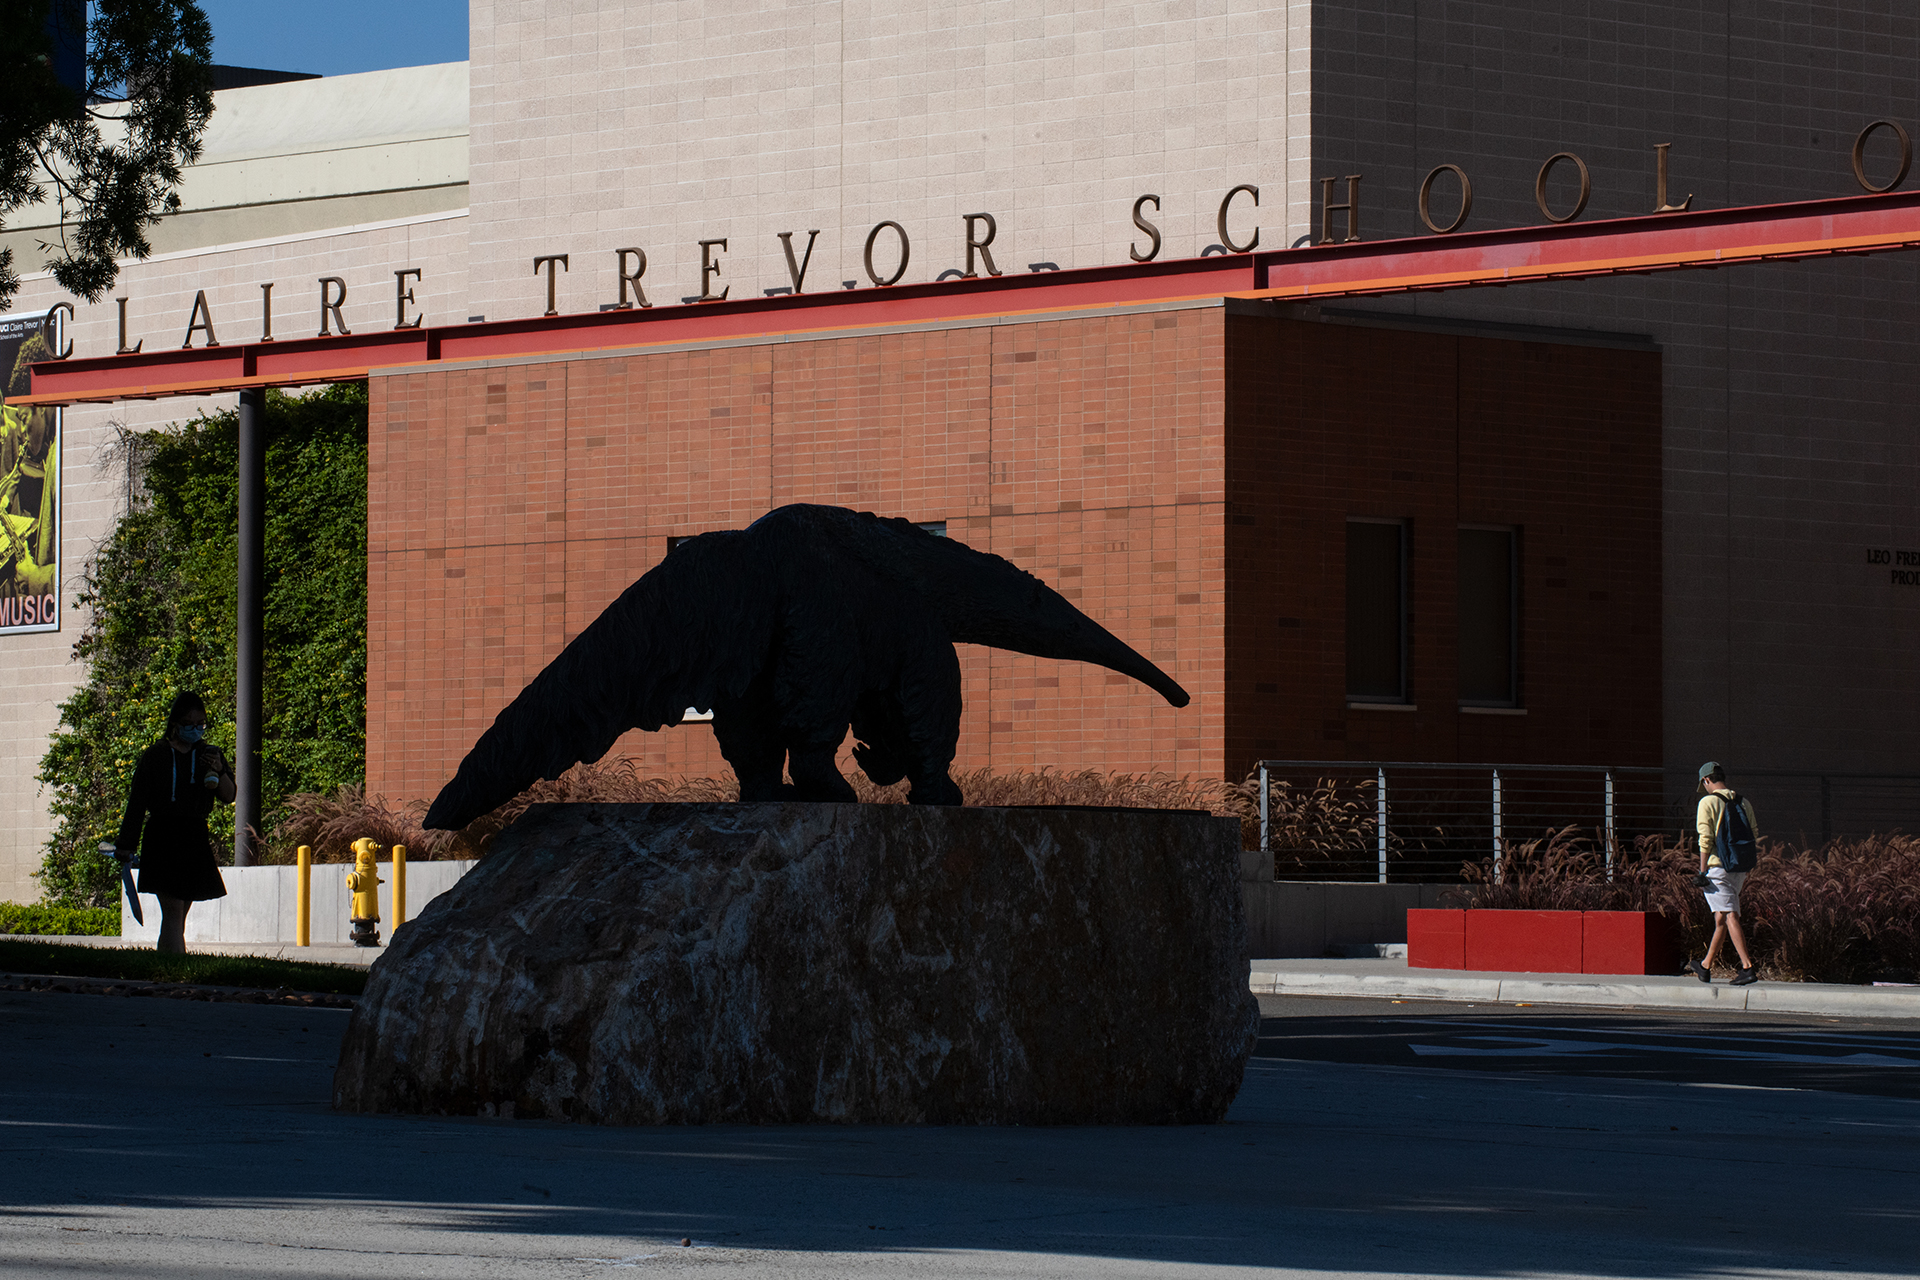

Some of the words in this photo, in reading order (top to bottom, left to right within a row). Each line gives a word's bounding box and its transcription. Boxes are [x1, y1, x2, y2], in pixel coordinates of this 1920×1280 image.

[43, 267, 423, 361] CLAIRE
[533, 212, 1001, 317] TREVOR
[1129, 142, 1693, 262] SCHOOL
[10, 322, 23, 332] Claire
[24, 321, 38, 330] Trevor
[1867, 549, 1890, 564] LEO
[1896, 551, 1920, 566] FRE
[0, 594, 54, 626] MUSIC
